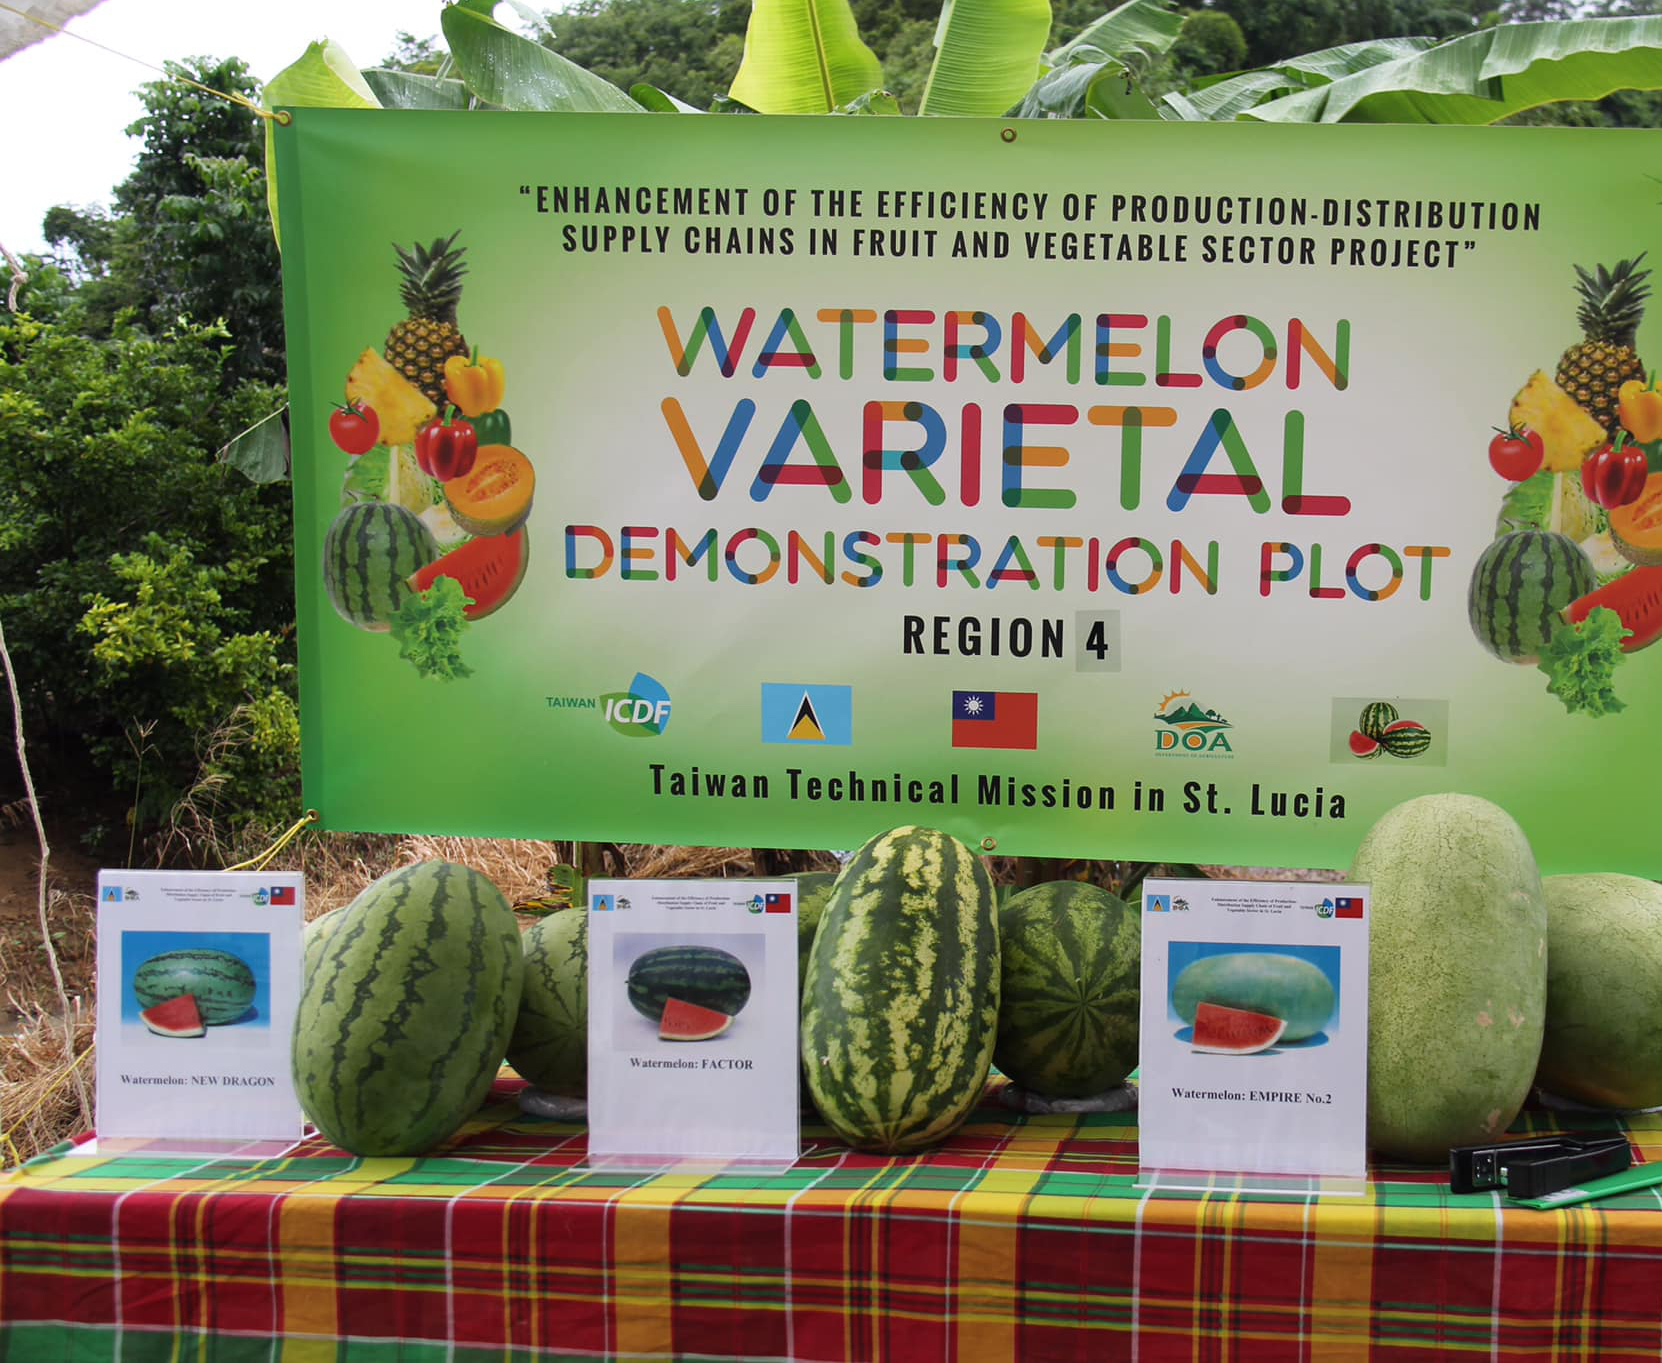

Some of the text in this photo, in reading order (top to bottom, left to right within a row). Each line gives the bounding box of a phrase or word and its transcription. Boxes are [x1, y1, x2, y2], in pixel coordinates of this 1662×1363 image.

[763, 188, 797, 216] OF
[810, 189, 863, 217] THE
[877, 190, 1048, 220] EFFICIENCY
[1063, 193, 1097, 221] OF
[1112, 194, 1540, 231] PRODUCTION-DISTRIBUTION
[562, 224, 670, 253] SUPPLY
[684, 226, 794, 255] CHAINS
[809, 228, 837, 256] IN
[853, 229, 938, 257] FRUIT
[951, 230, 1009, 258] AND
[1024, 232, 1188, 262] VEGETABLE
[1202, 235, 1315, 265] SECTOR
[656, 304, 1350, 391] WATERMELON
[660, 396, 1352, 516] VARIETAL
[564, 524, 1452, 601] DEMONSTRATION PLOT
[903, 615, 1109, 660] REGION 4
[545, 696, 672, 724] TAIWAN ICDF
[1154, 729, 1233, 752] DOA
[649, 764, 1345, 819] Taiwan Technical Mission in St. Lucia
[120, 1074, 275, 1088] Watermelon: NEW DRAGON
[630, 1057, 753, 1071] Watermelon: FACTOR
[1171, 1087, 1332, 1105] Watermelon: EMPIRE No.2
